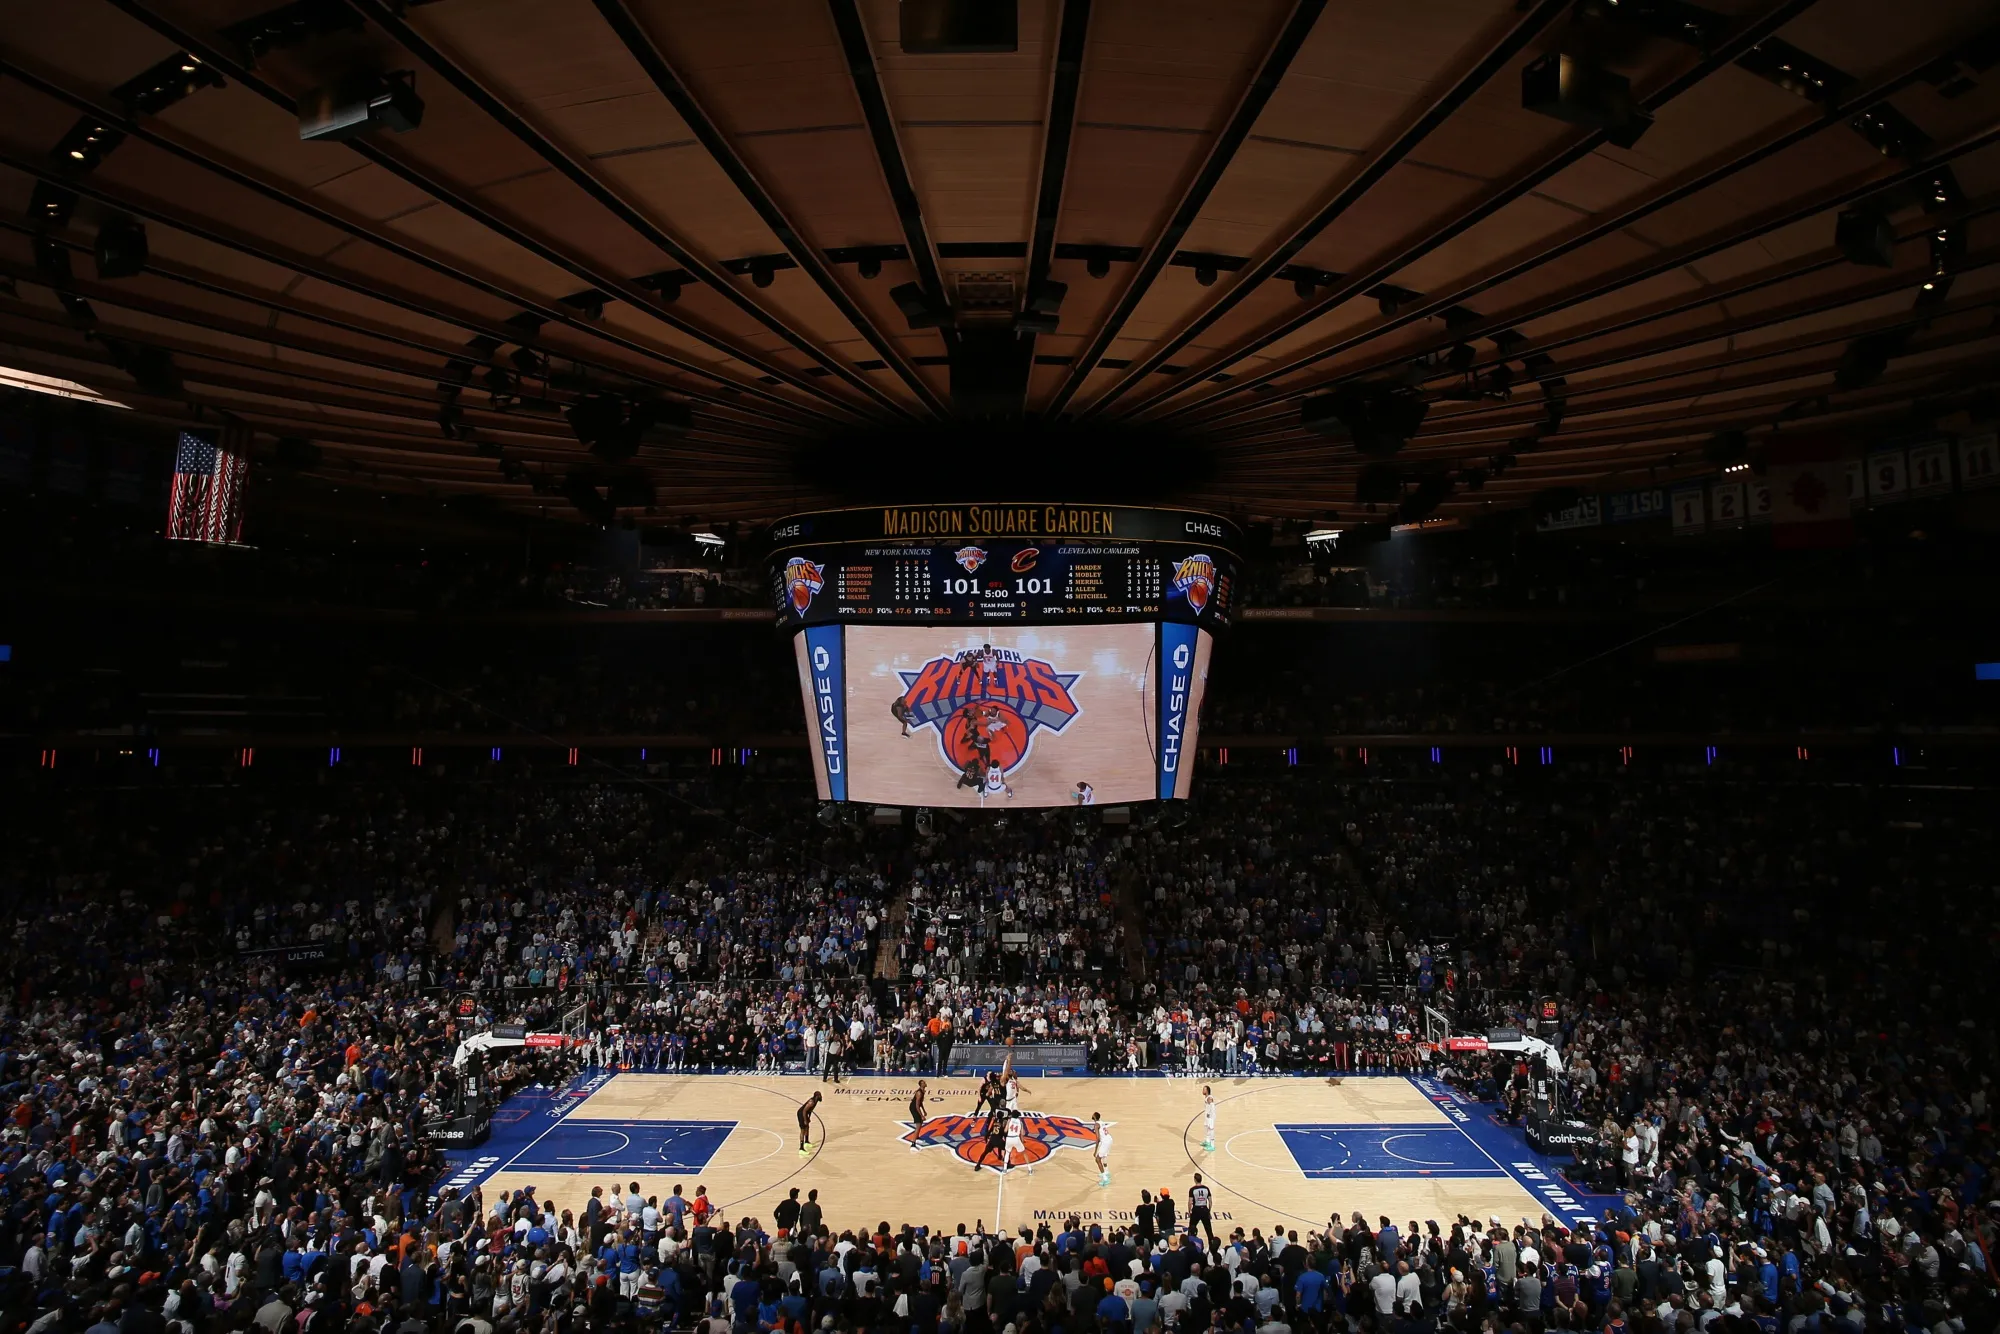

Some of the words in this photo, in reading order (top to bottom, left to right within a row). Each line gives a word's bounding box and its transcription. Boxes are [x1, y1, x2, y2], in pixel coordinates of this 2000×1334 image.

[1879, 466, 1895, 491] 9
[1631, 489, 1664, 514] 150
[1721, 495, 1735, 518] 2
[884, 509, 962, 535] MADISON
[969, 506, 1038, 534] SQUARE
[1045, 507, 1113, 534] GARDEN
[1683, 502, 1693, 523] 1
[774, 525, 800, 540] CHASE
[1185, 521, 1222, 537] CHASE
[943, 578, 980, 595] 101
[1015, 578, 1053, 594] 101
[984, 589, 1008, 598] 5:00
[815, 676, 841, 774] CHASE
[1163, 674, 1187, 773] CHASE
[989, 774, 999, 783] 44
[287, 950, 325, 961] ULTRA
[1543, 1009, 1554, 1017] 24
[1017, 1052, 1030, 1060] GAME
[1031, 1052, 1034, 1060] 2
[578, 1074, 610, 1092] ULTRA
[1439, 1101, 1471, 1122] ULTRA
[1009, 1124, 1018, 1132] 44
[443, 1156, 500, 1191] KNICKS
[1511, 1162, 1549, 1180] NEW
[1538, 1184, 1585, 1212] YORK
[1033, 1209, 1102, 1220] MADISON
